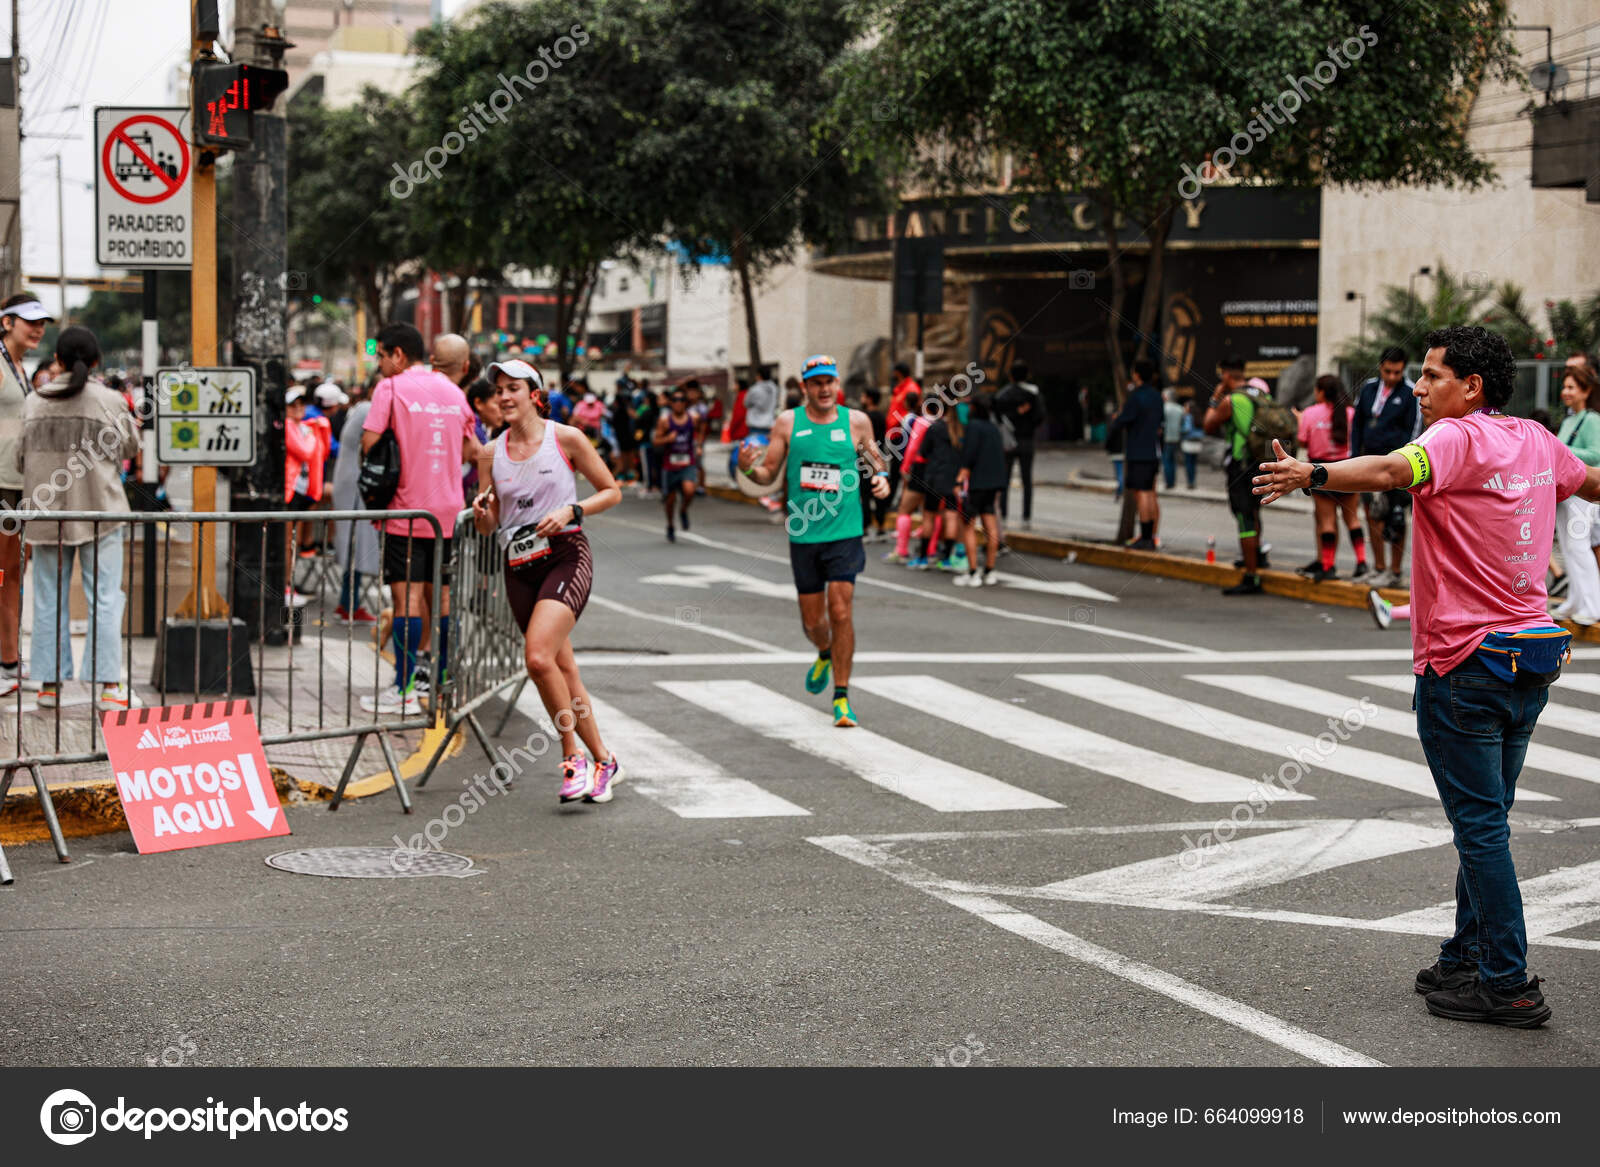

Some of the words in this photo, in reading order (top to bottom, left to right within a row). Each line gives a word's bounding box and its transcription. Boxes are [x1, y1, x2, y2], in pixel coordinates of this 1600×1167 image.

[108, 215, 185, 233] PARADERO
[1072, 200, 1207, 231] CIY
[108, 239, 186, 258] PROHIBIDO
[811, 470, 829, 480] 272
[117, 760, 242, 803] MOTOS
[152, 788, 235, 838] AQUÍ
